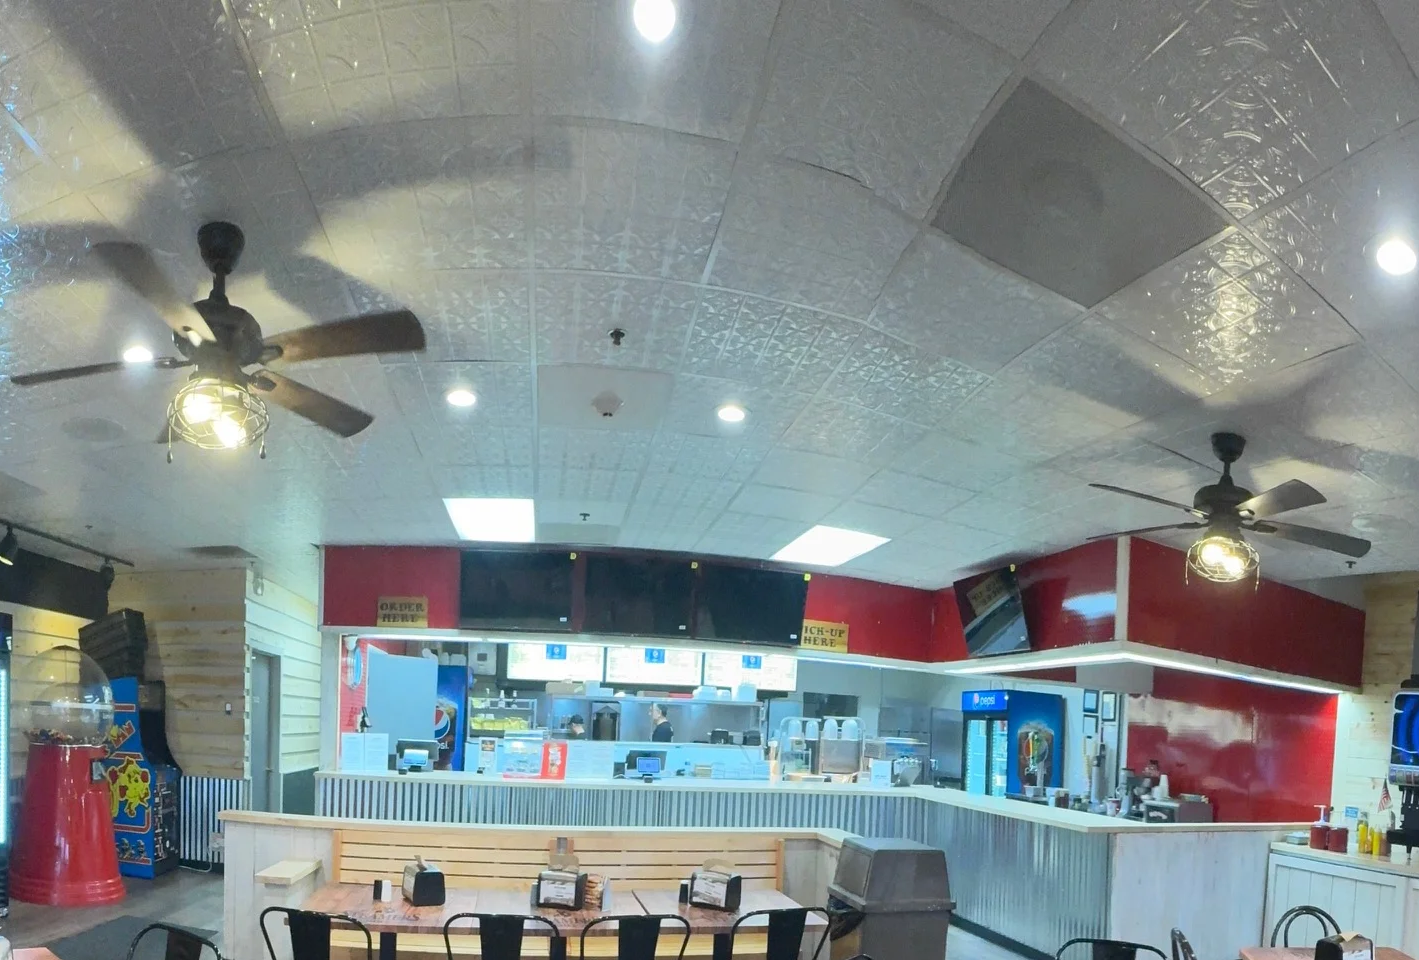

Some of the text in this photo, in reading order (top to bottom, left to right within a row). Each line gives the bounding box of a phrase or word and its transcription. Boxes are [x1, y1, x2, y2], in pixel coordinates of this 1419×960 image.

[380, 602, 424, 612] ORDER
[382, 614, 418, 623] HERE
[803, 625, 846, 638] ICK-UP
[803, 636, 837, 648] HERE
[980, 695, 996, 707] pepsi
